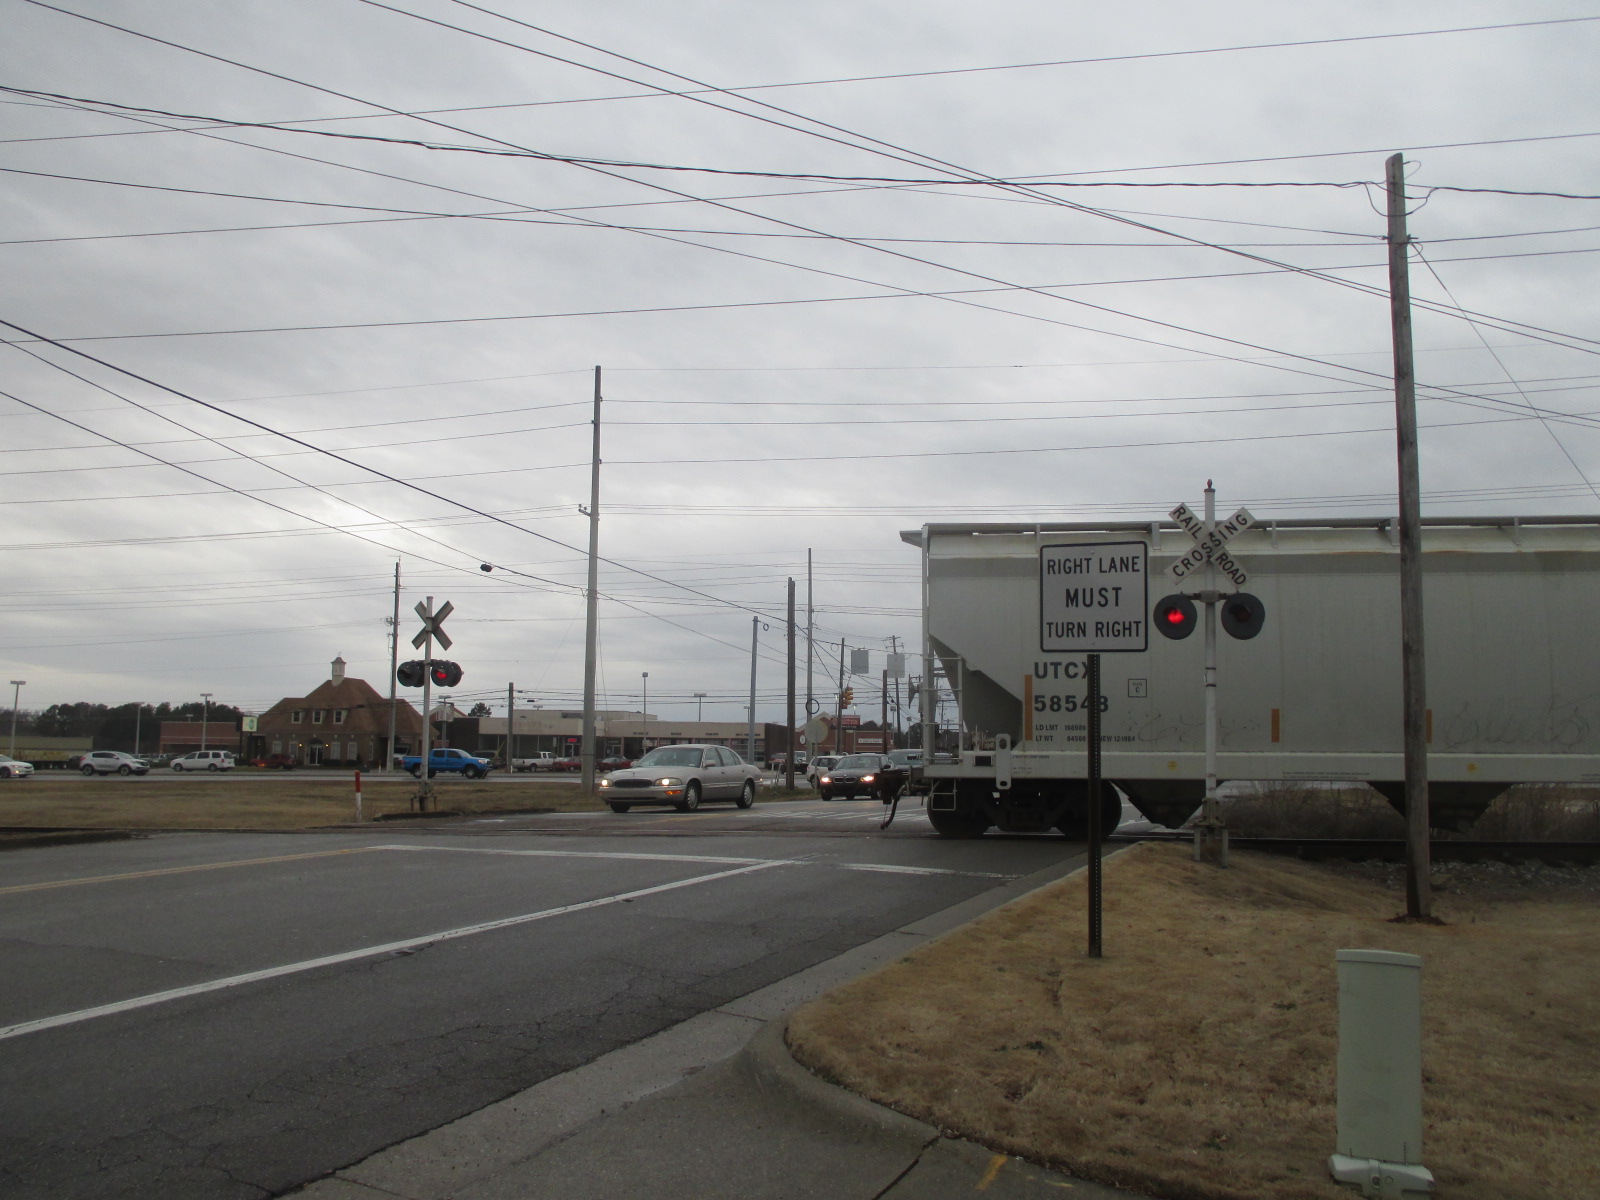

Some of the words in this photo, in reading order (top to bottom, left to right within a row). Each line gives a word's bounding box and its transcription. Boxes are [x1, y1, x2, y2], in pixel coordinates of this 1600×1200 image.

[1172, 514, 1248, 577] CROSSING
[1173, 506, 1202, 540] RAIL
[1215, 552, 1247, 585] ROAD
[1047, 558, 1092, 574] RIGHT
[1099, 556, 1140, 573] LANE
[1065, 587, 1122, 608] MUST
[1046, 622, 1086, 638] TURN
[1095, 621, 1142, 637] RIGHT
